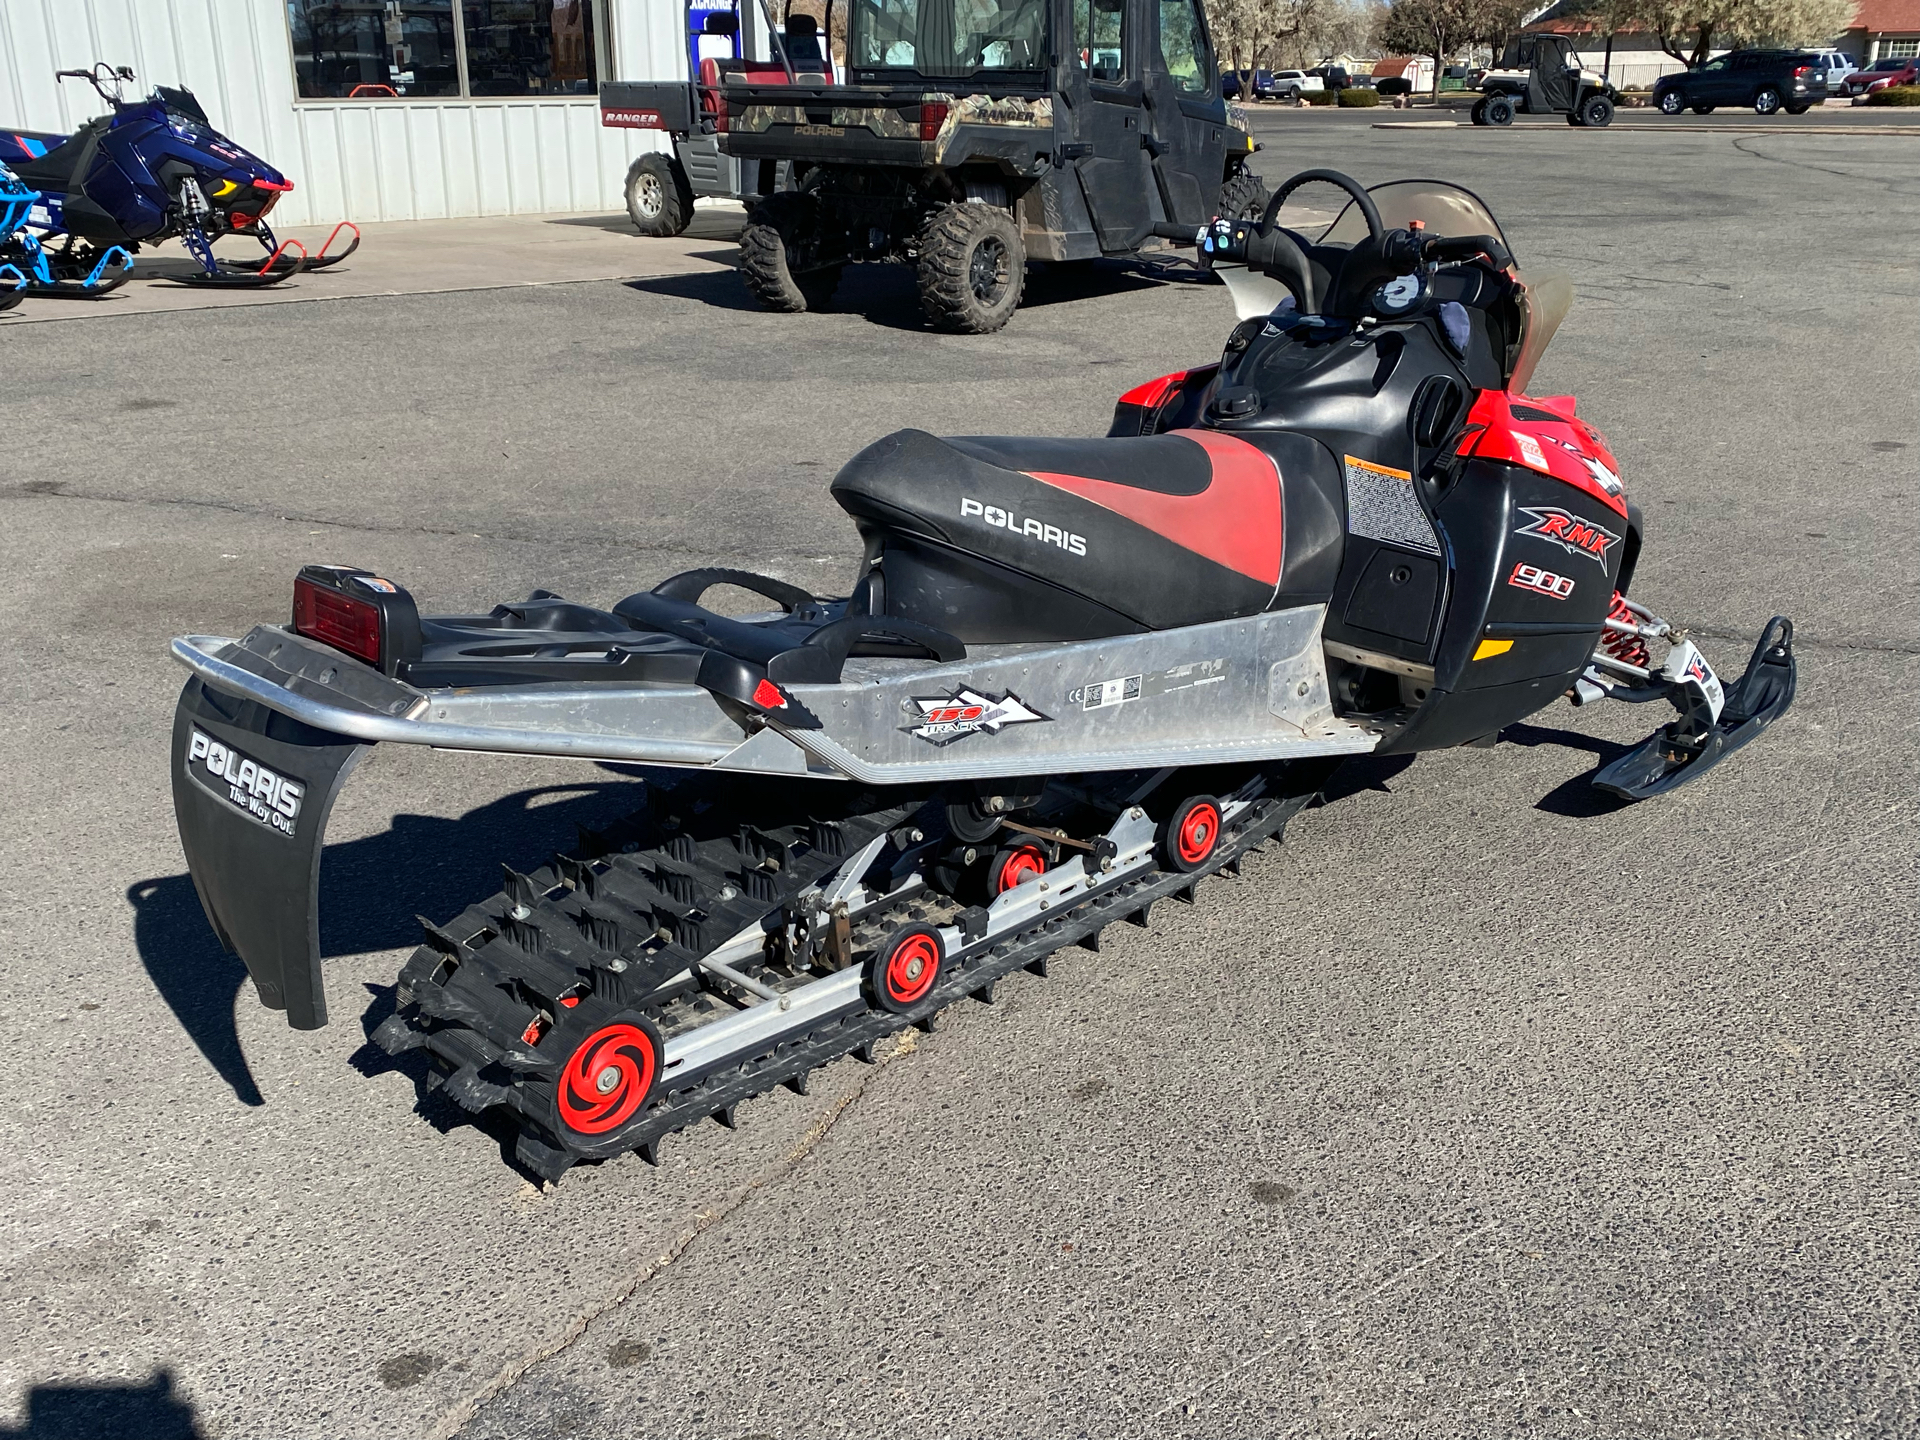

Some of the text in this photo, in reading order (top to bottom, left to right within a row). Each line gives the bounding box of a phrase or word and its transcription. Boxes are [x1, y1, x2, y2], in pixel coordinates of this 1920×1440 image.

[605, 113, 658, 123] RANGER
[794, 126, 846, 137] POLARIS
[977, 109, 1035, 121] RANGER
[960, 497, 1087, 557] POLARIS
[1536, 513, 1612, 556] RMK
[1509, 562, 1576, 600] 900
[922, 721, 982, 734] TRACK
[189, 731, 300, 818] POLARIS
[229, 785, 294, 835] The Way Out.
